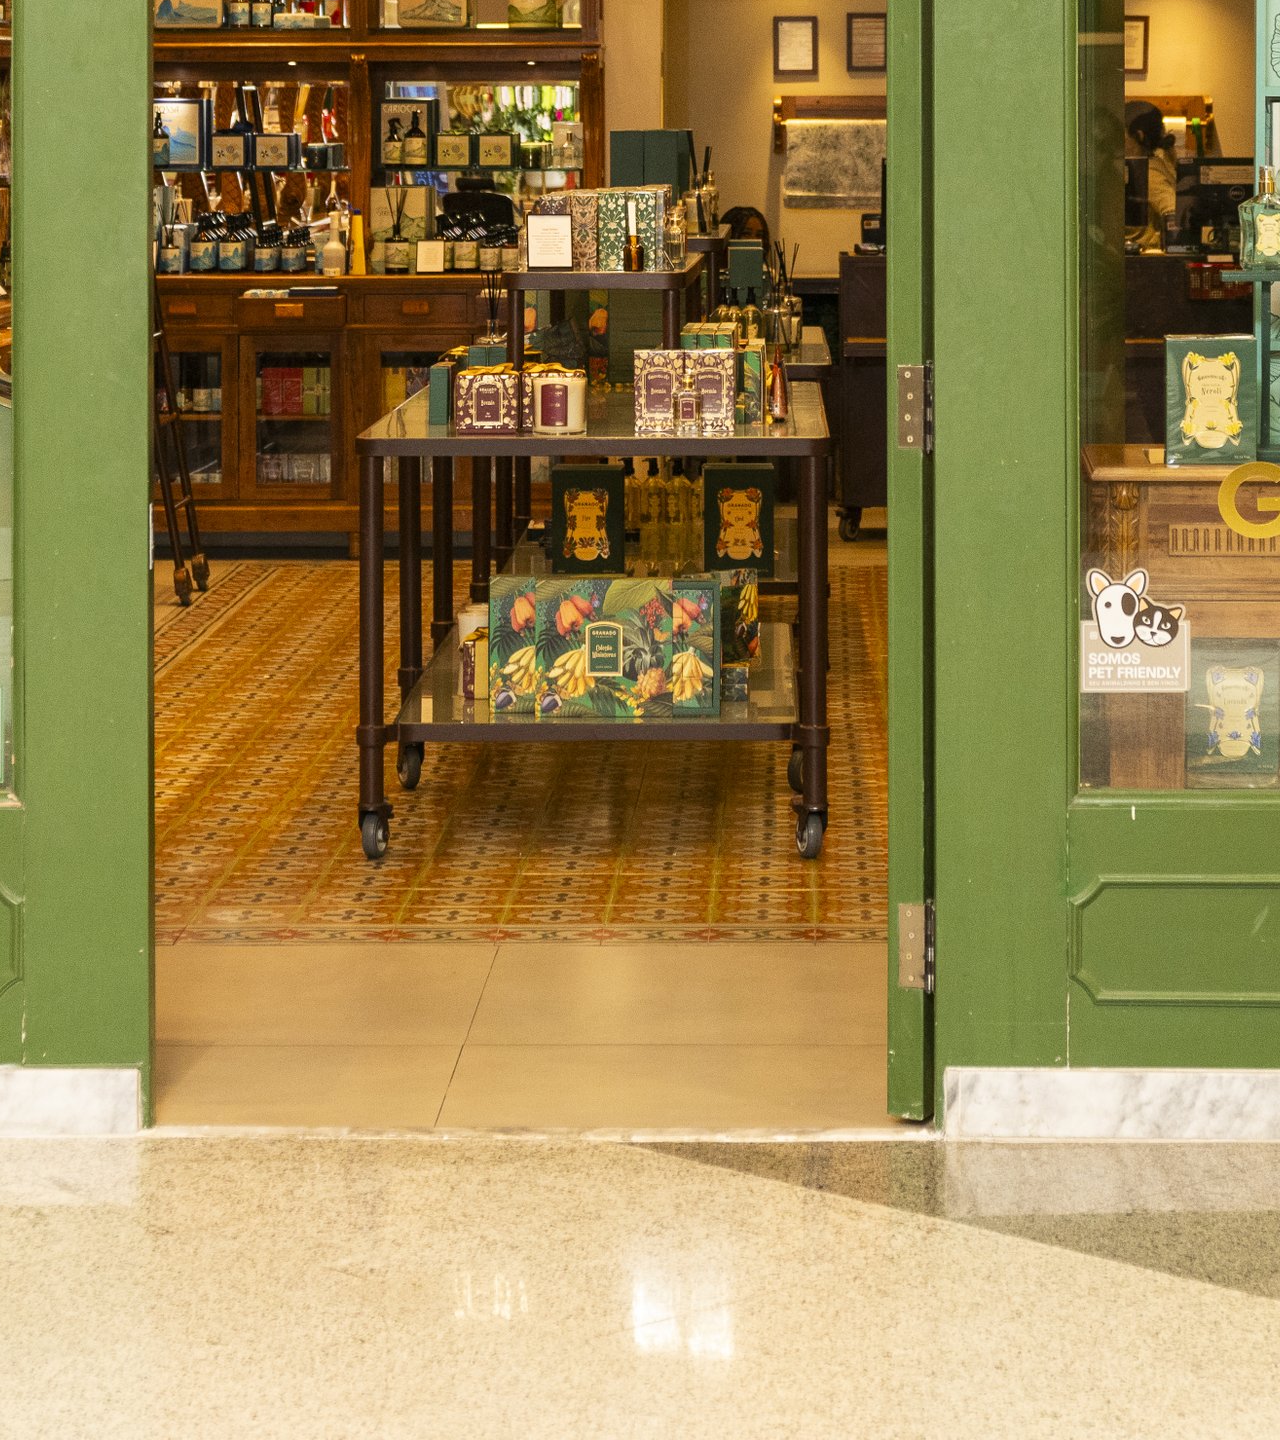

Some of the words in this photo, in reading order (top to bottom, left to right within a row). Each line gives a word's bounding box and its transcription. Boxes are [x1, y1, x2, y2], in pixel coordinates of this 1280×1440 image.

[1201, 387, 1223, 396] Neroli
[1088, 652, 1141, 665] SOMOS
[1088, 666, 1114, 679] PET
[1117, 666, 1182, 679] FRIENDLY
